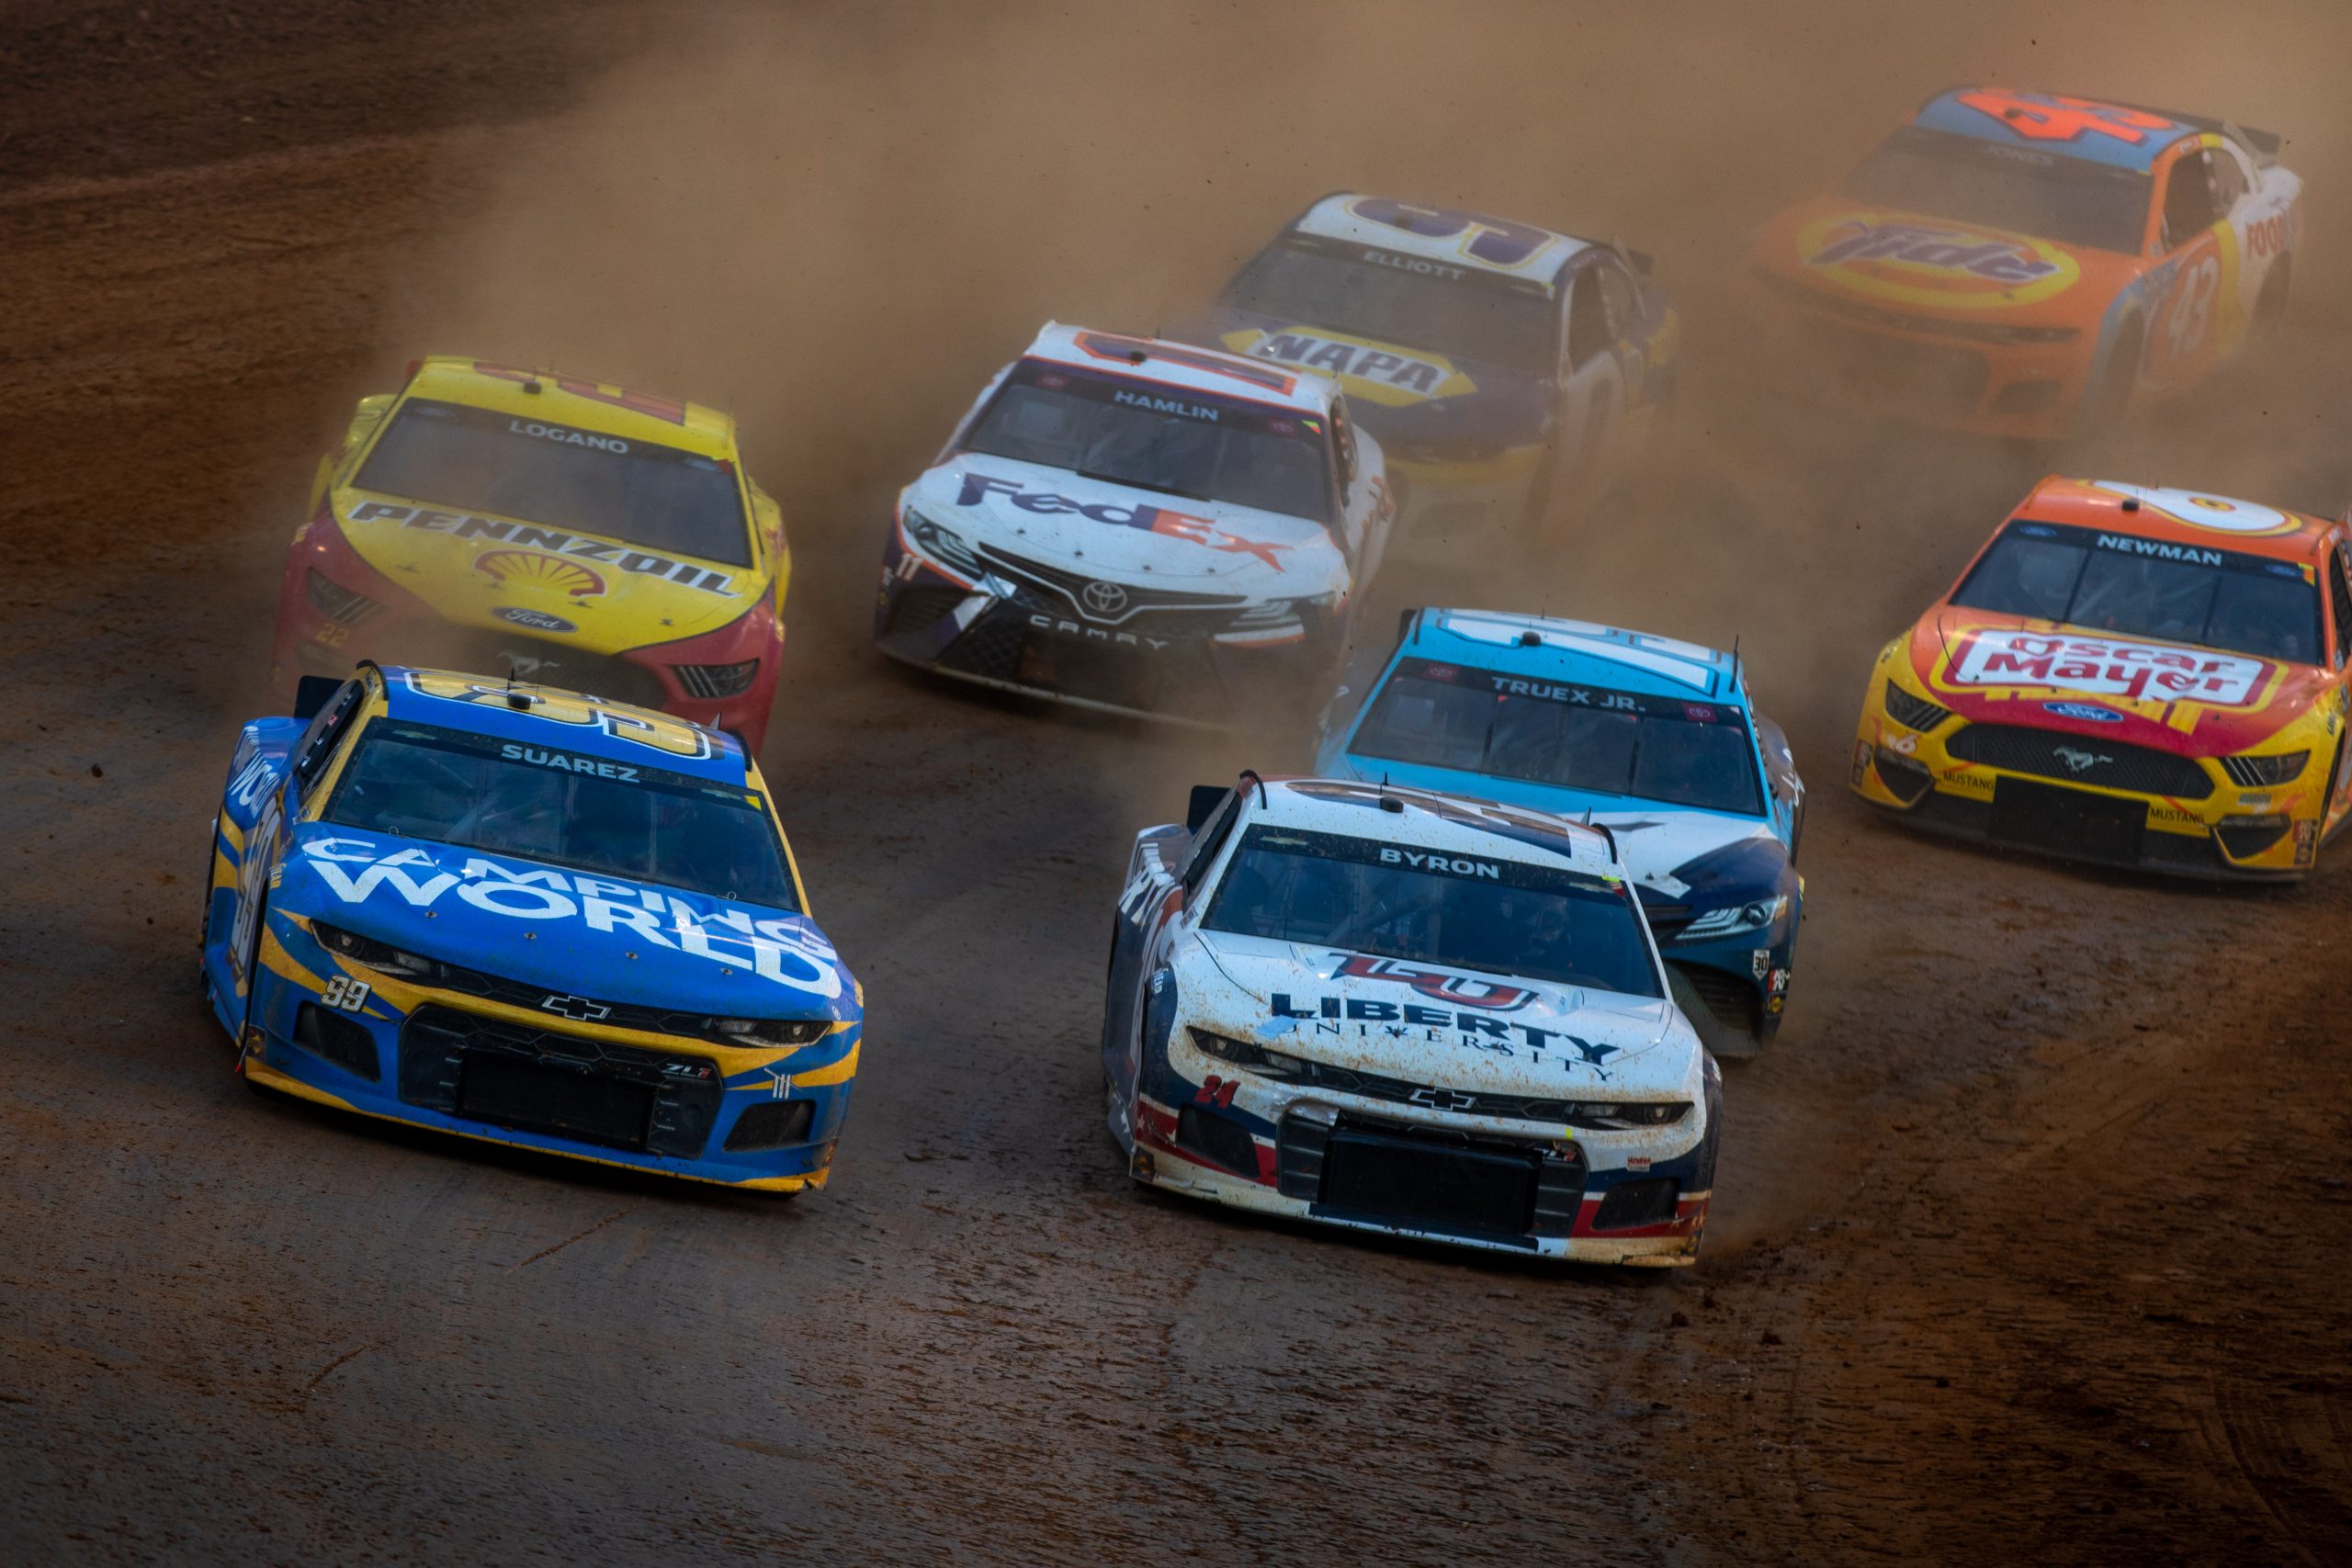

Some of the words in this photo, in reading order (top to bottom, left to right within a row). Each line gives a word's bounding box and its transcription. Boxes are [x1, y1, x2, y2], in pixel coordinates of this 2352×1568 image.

[1363, 249, 1467, 281] ELLIOTT
[1256, 333, 1441, 393] NAPA
[1114, 390, 1219, 422] HAMLIN
[509, 419, 629, 455] LOGANO
[956, 471, 1295, 573] FedEx
[347, 502, 741, 598] PENNZOIL
[2097, 534, 2222, 567] NEWMAN
[315, 622, 349, 648] 22
[504, 605, 562, 631] Ford
[1029, 614, 1170, 650] CAMRY
[2008, 637, 2235, 673] Oscar
[1983, 652, 2239, 698] Mayer
[1491, 675, 1591, 706] TRUEX
[1600, 696, 1647, 714] JR.
[501, 743, 641, 784] SUAREZ
[1943, 770, 1995, 791] MUSTANG
[2150, 807, 2206, 824] MUSTANG
[1379, 847, 1500, 880] BYRON
[301, 837, 838, 962] CAMPING
[307, 859, 842, 999] WORLD
[1754, 956, 1769, 972] 30
[320, 974, 372, 1014] 99
[1271, 992, 1622, 1066] LIBERTY
[1193, 1074, 1241, 1110] 24
